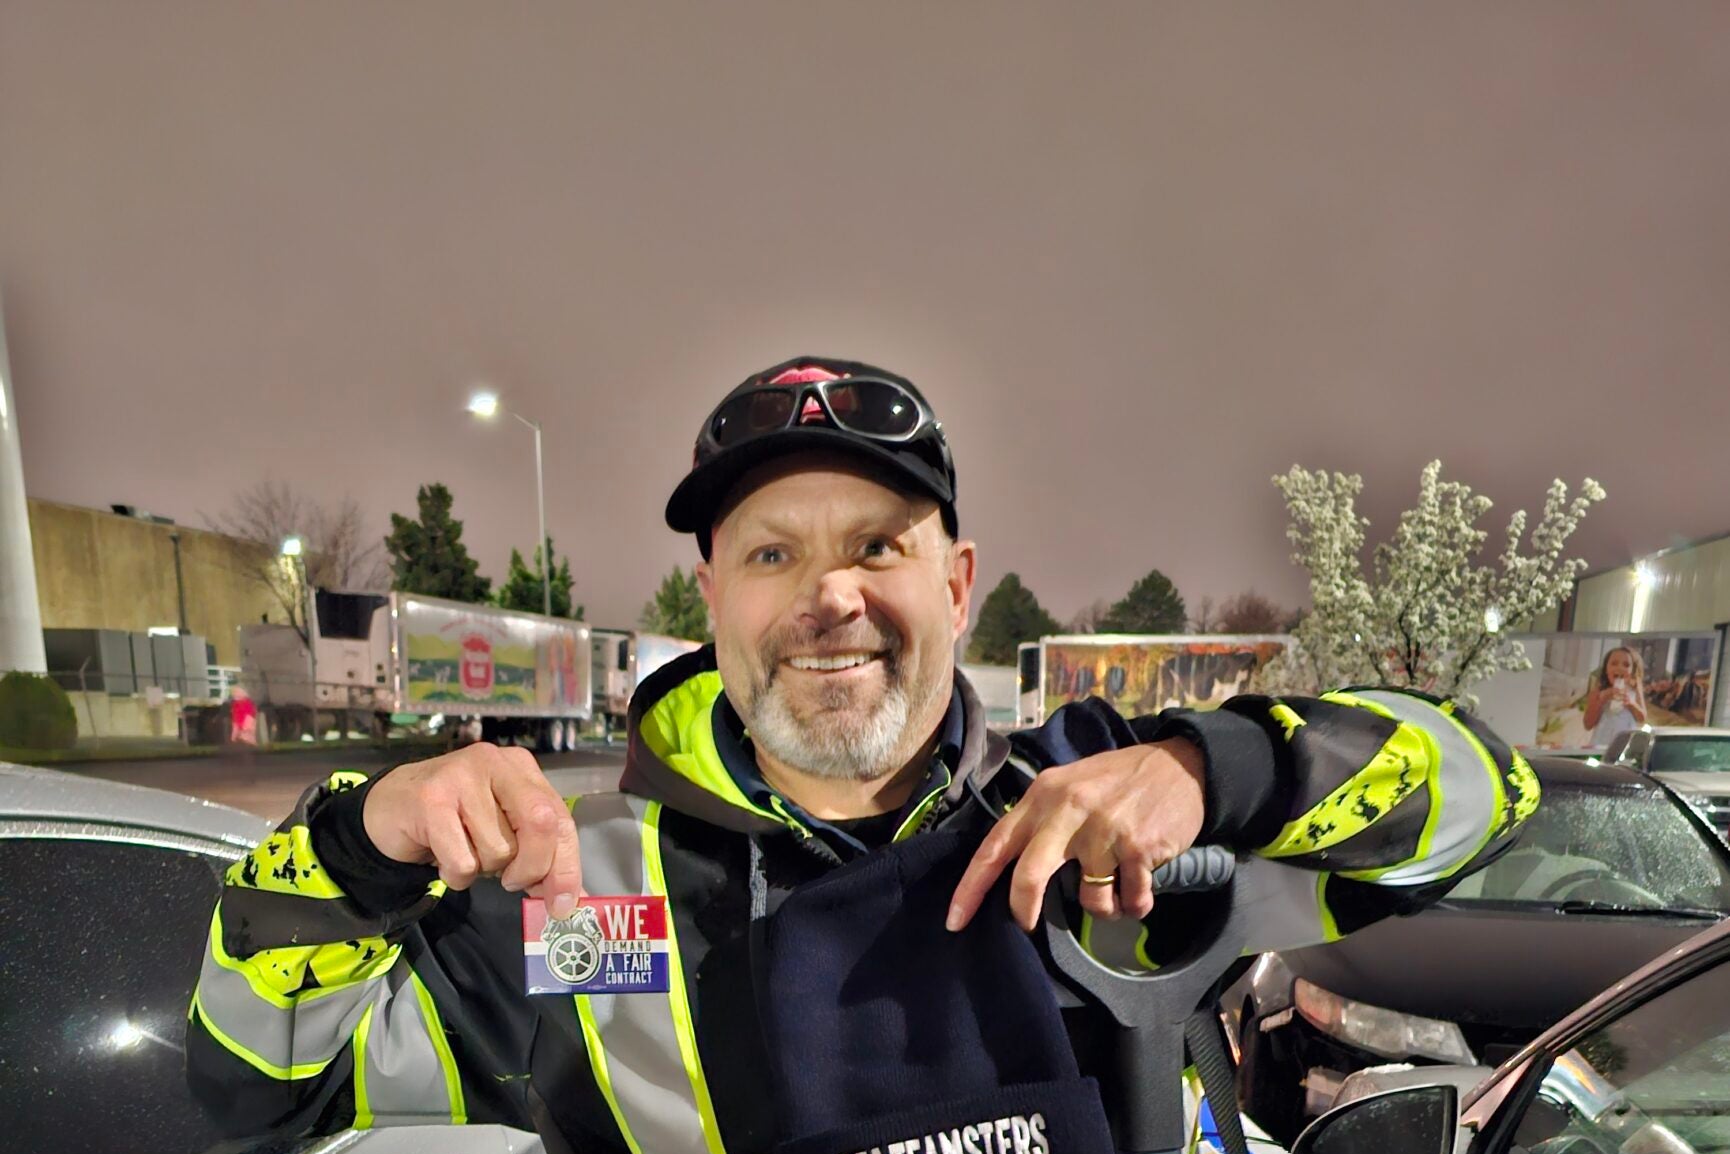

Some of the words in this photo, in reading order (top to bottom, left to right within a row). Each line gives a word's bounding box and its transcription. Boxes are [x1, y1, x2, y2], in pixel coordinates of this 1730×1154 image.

[604, 905, 649, 940] WE
[605, 941, 651, 952] DEMAND
[606, 953, 615, 972] A
[623, 953, 652, 972] FAIR
[606, 972, 653, 984] CONTRACT
